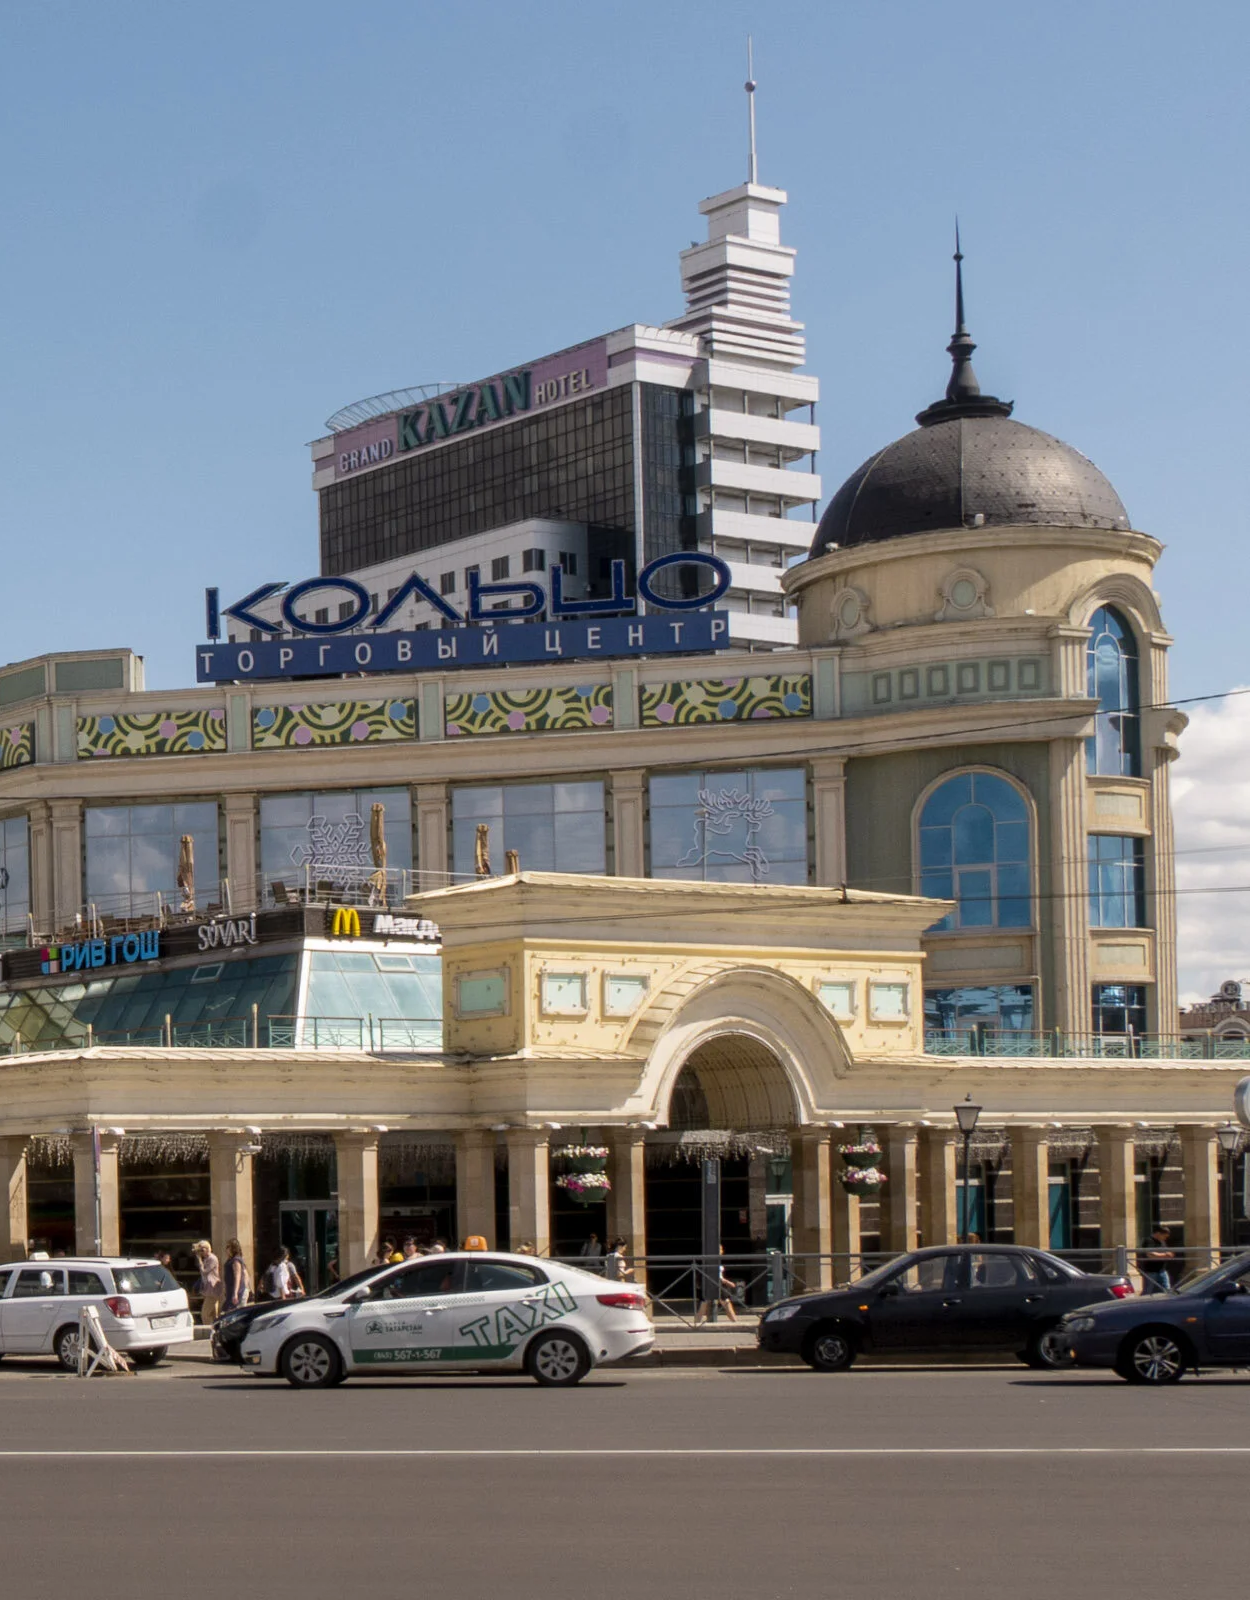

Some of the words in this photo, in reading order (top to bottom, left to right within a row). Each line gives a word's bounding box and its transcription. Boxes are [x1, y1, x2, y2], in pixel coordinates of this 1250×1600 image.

[339, 438, 393, 473] GRAND
[398, 370, 531, 451] KAZAN
[535, 368, 593, 405] HOTEL
[205, 551, 731, 640] КОЛЬЦО
[200, 623, 499, 674] ТОРГОВЫЙ
[545, 617, 726, 654] ЦЕНТР
[61, 938, 105, 973] РИВ
[111, 930, 160, 965] ГОШ
[459, 1281, 578, 1347] TAXI
